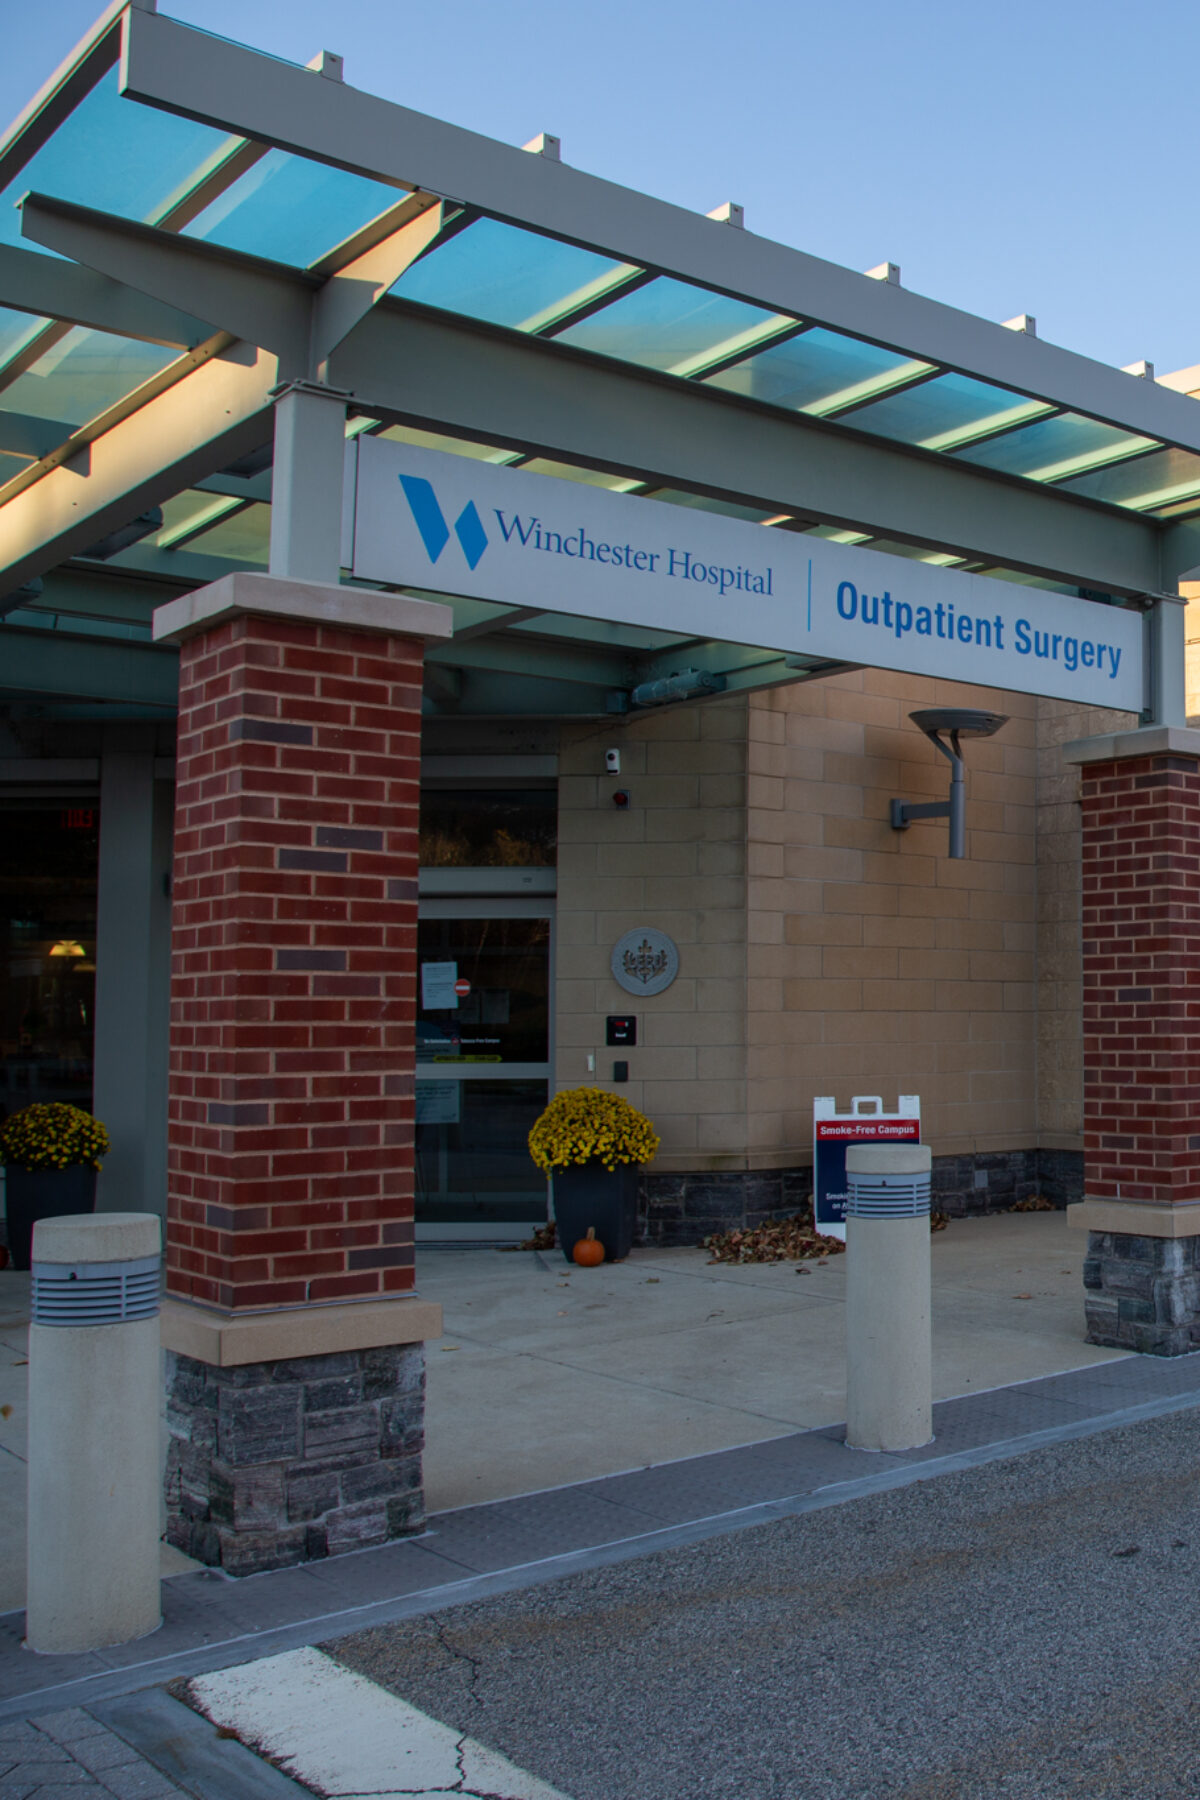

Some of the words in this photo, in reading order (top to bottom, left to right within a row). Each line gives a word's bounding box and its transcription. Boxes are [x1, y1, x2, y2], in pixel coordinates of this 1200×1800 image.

[493, 508, 661, 573] Winchester
[666, 548, 775, 597] Hospital
[836, 581, 1005, 650] Outpatient
[1014, 618, 1122, 679] Surgery
[820, 1126, 876, 1135] Smoke-Free
[878, 1125, 915, 1135] Campus
